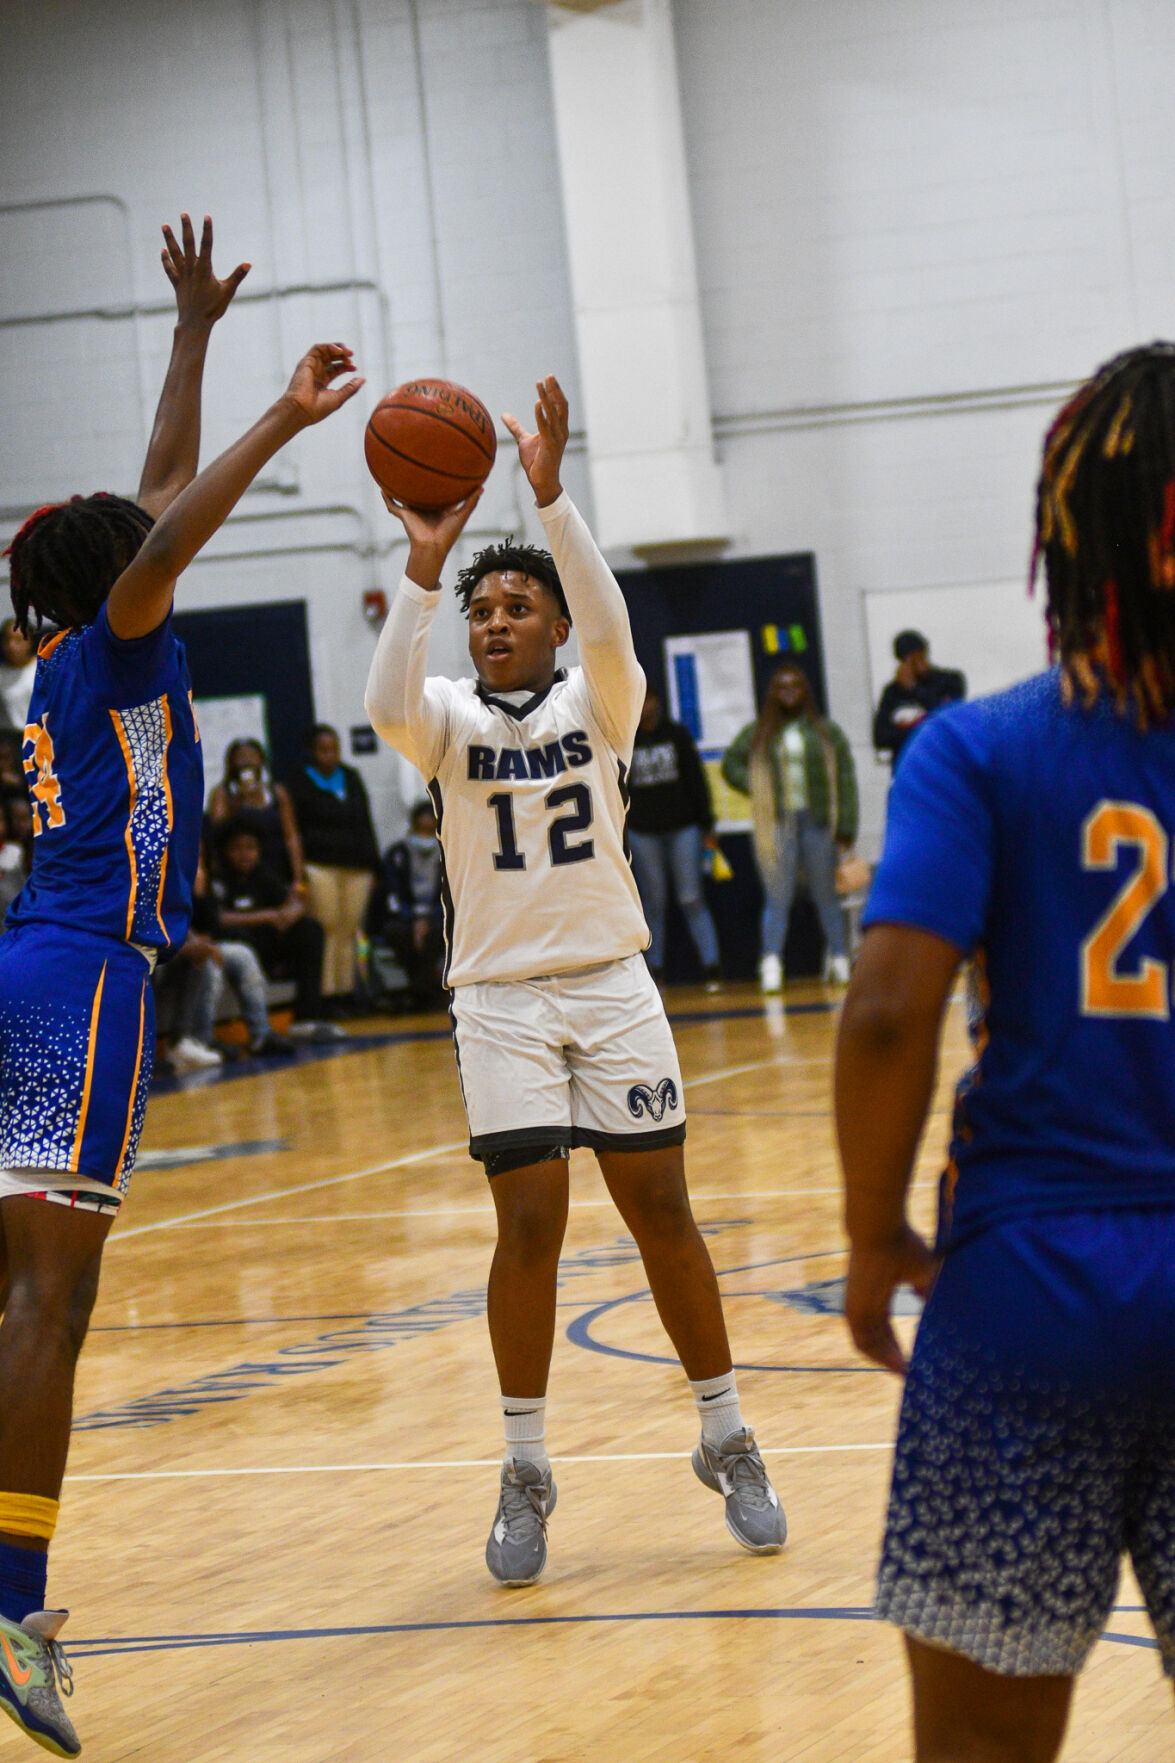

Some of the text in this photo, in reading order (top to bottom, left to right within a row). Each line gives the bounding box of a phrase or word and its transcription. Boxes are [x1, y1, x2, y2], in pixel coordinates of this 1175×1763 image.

[468, 730, 593, 781] RAMS
[487, 781, 595, 871] 12
[1080, 798, 1175, 1020] 2
